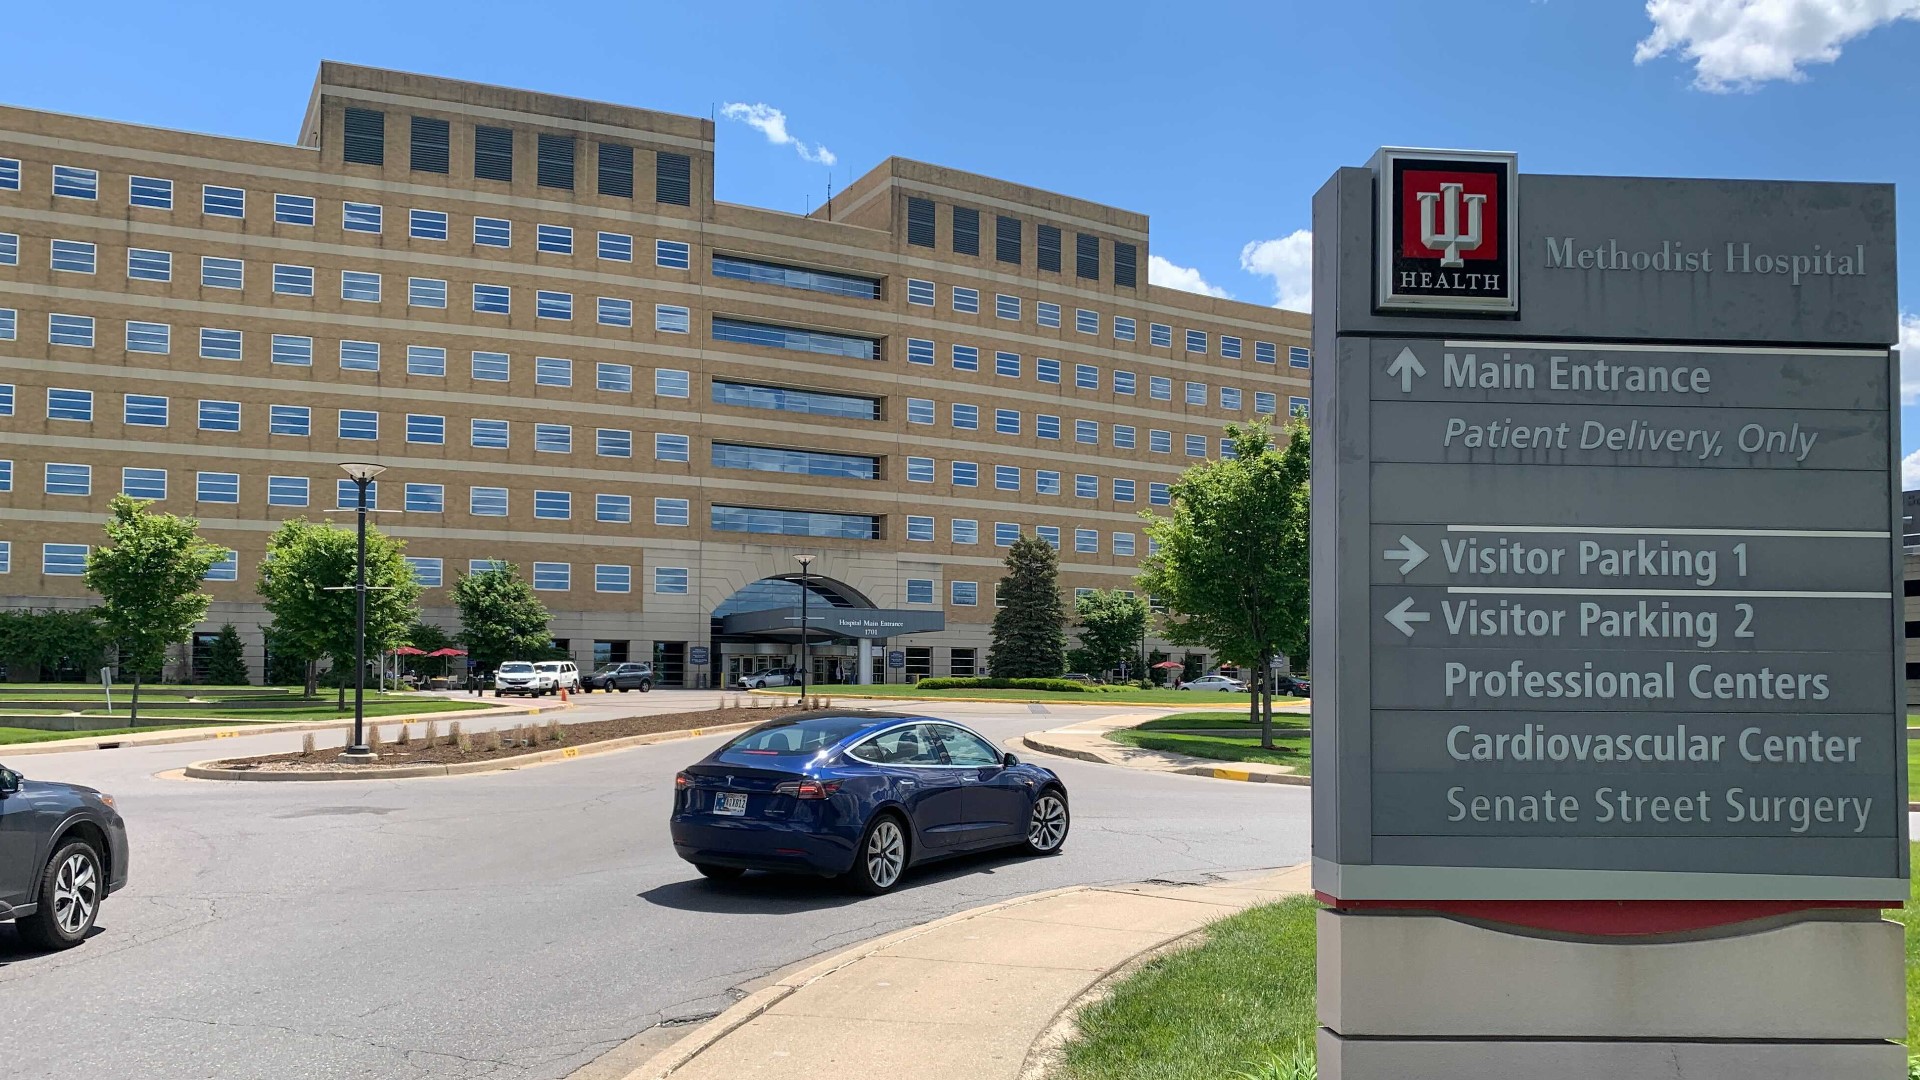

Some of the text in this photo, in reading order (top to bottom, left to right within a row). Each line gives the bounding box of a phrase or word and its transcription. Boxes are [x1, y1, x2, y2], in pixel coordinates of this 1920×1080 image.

[1400, 271, 1500, 291] HEALTH
[1544, 236, 1867, 286] Methodist Hospital
[1443, 352, 1711, 393] Main Entrance
[1443, 417, 1819, 462] Patient Delivery, Only
[1440, 538, 1747, 587] Visitor Parking 1
[839, 619, 862, 627] Hospital
[1440, 600, 1755, 648] Visitor Parking 2
[1445, 659, 1830, 700] Professional Centers
[1446, 723, 1862, 763] Cardiovascular Center
[1447, 786, 1873, 833] Senate Street Surgery
